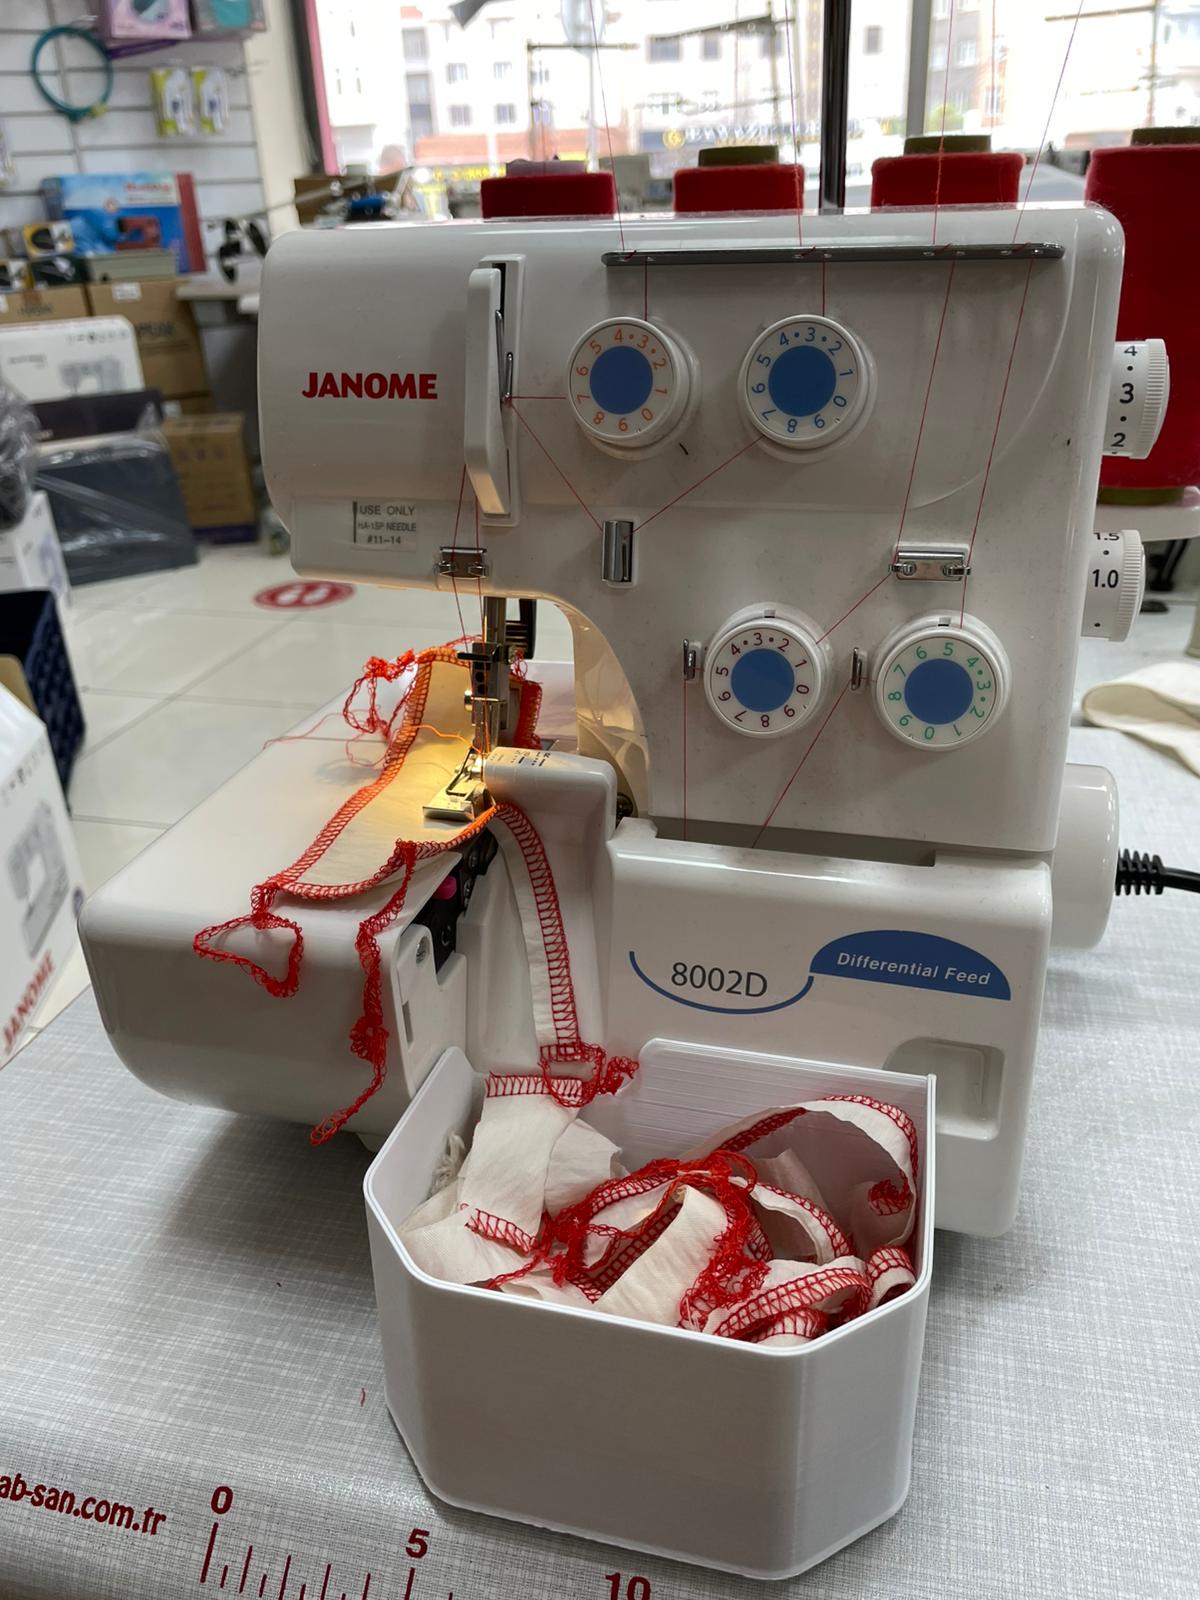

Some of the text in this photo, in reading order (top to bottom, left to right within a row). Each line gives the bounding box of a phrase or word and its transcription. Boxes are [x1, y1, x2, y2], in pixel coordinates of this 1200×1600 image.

[614, 329, 624, 342] 4
[780, 332, 789, 345] 4
[805, 327, 815, 342] 3
[589, 340, 601, 354] 5
[637, 335, 649, 348] 3
[828, 341, 842, 356] 2
[1123, 345, 1138, 356] 4
[653, 358, 666, 370] 2
[757, 354, 771, 367] 5
[576, 366, 589, 376] 6
[302, 372, 437, 399] JANOME
[752, 383, 765, 393] 6
[577, 394, 590, 404] 7
[1119, 382, 1135, 404] 3
[833, 396, 847, 407] 0
[594, 411, 604, 424] 8
[641, 408, 653, 421] 0
[762, 409, 776, 420] 7
[814, 414, 825, 428] 9
[619, 418, 628, 431] 9
[787, 418, 797, 433] 8
[1110, 432, 1126, 447] 2
[360, 504, 416, 516] USE ONLY
[386, 522, 417, 532] NEEDLE
[1093, 532, 1120, 541] 1.5
[1092, 569, 1119, 588] 1.0
[716, 632, 809, 727] 4 3 2 1 0 9 8 7 6 5
[888, 642, 991, 740] 5 4 3 2 1 0 9 8 7 6
[837, 952, 991, 985] Differential Feed
[671, 962, 768, 997] 8002D
[0, 1473, 166, 1535] ab-san.com.tr
[211, 1486, 234, 1514] 0
[405, 1529, 430, 1558] 5
[606, 1572, 651, 1600] 10
